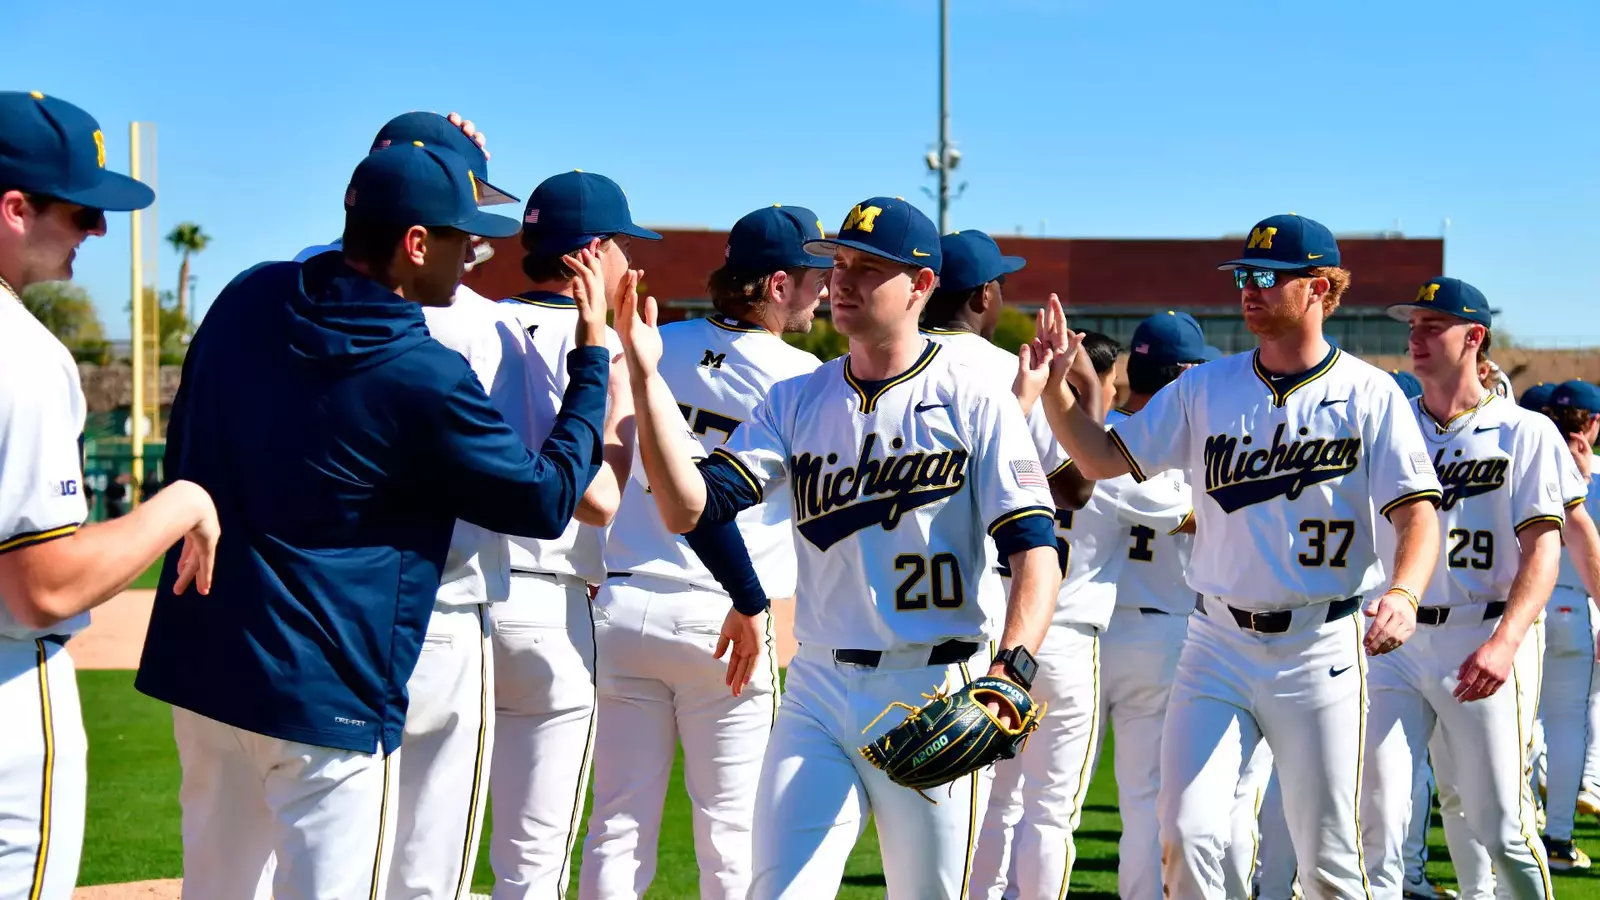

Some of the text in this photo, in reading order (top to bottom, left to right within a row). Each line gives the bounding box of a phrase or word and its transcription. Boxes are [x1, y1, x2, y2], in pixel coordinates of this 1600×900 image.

[842, 204, 883, 233] M
[1246, 226, 1278, 249] M
[1413, 283, 1440, 302] M
[699, 349, 727, 370] M
[790, 433, 968, 532] Michigan
[1203, 422, 1362, 501] Michigan
[1432, 447, 1510, 512] higan
[1298, 519, 1356, 568] 37
[1448, 528, 1495, 570] 29
[894, 552, 966, 611] 20
[912, 734, 949, 767] A2000
